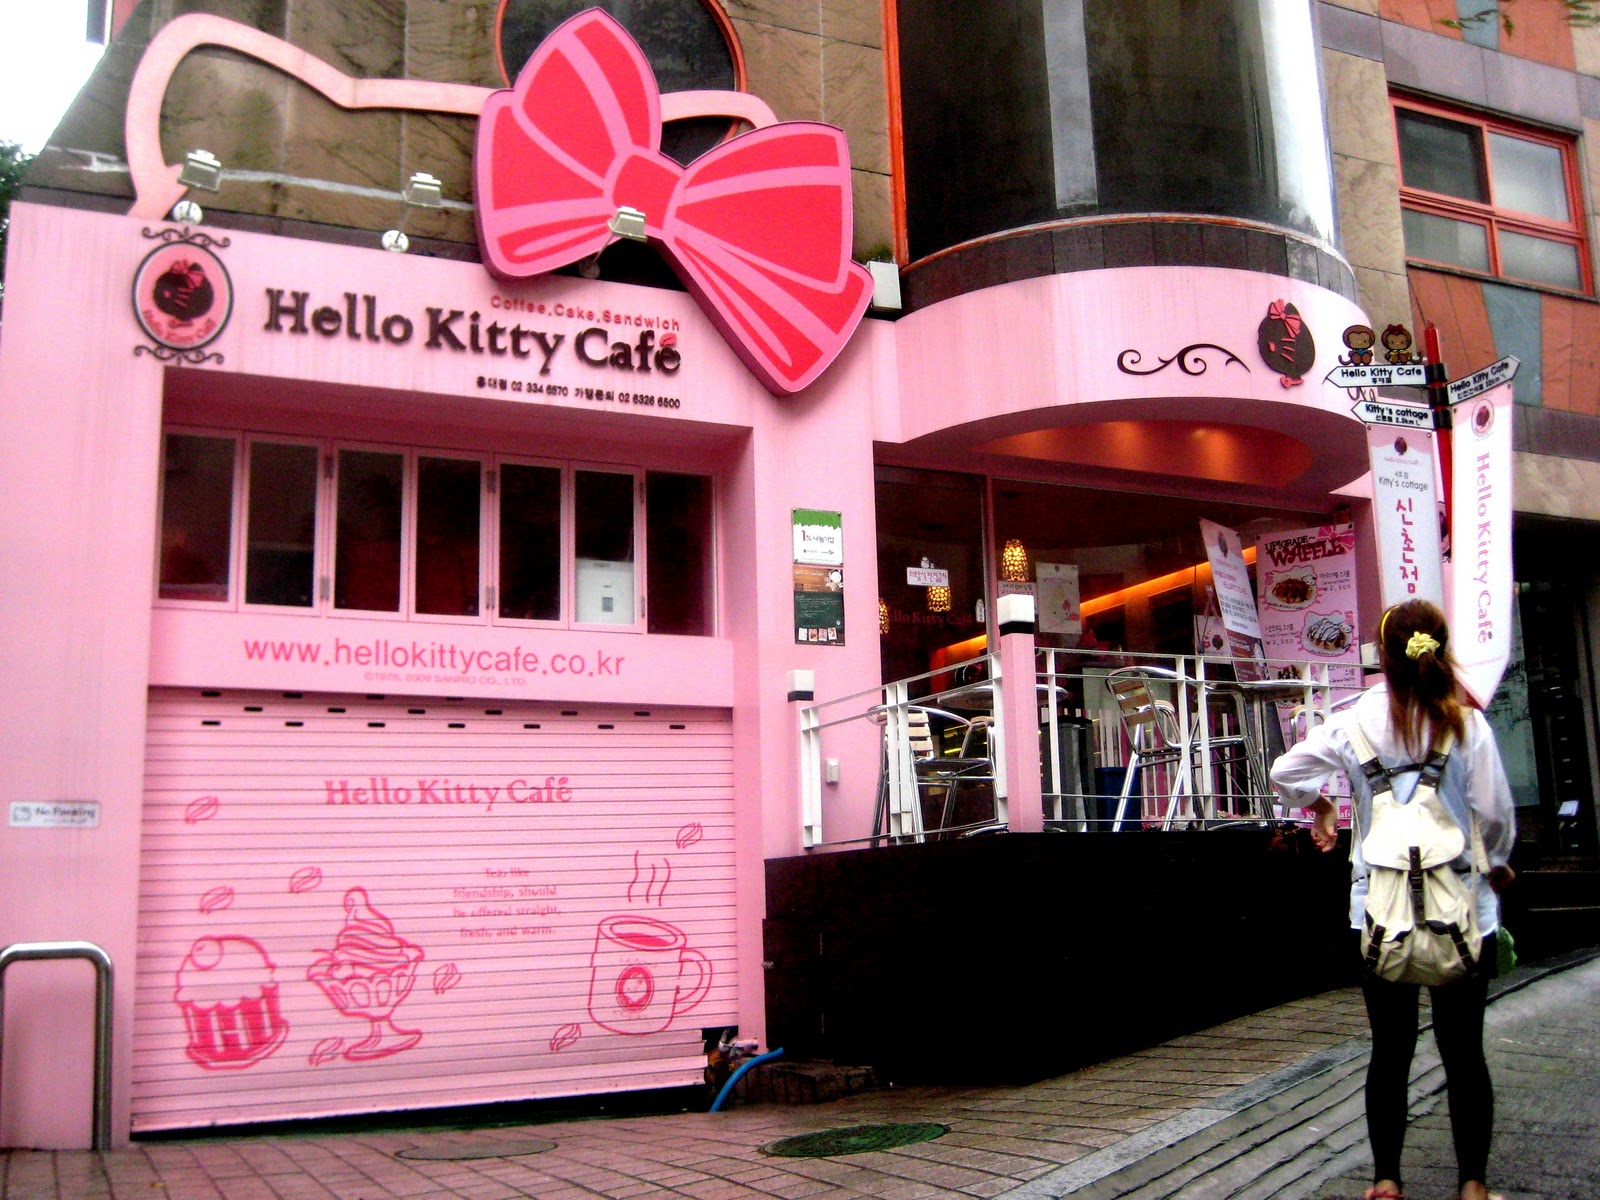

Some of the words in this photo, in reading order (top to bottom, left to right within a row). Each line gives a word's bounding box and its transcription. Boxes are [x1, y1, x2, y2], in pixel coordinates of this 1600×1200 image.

[264, 288, 414, 346] Hello
[424, 307, 565, 377] Kitty
[1341, 368, 1367, 378] Hello
[1370, 367, 1393, 378] Kitty
[1396, 367, 1422, 377] Cafe
[1450, 380, 1471, 394] Hello
[1472, 371, 1489, 385] Kitty
[1490, 361, 1509, 376] Cafe
[511, 380, 522, 392] 02
[526, 382, 544, 394] 334
[618, 392, 630, 404] 02
[1365, 403, 1393, 416] Kitty's
[1395, 408, 1429, 420] cottage
[1379, 476, 1400, 488] Kitty's
[1401, 480, 1429, 492] cottage
[1476, 452, 1492, 518] Hello
[1266, 537, 1346, 567] WAFFLE
[1473, 521, 1492, 585] Kitty
[243, 637, 625, 677] www.hellokittycafe.co.kr
[324, 777, 412, 805] Hello
[418, 778, 500, 812] Kitty
